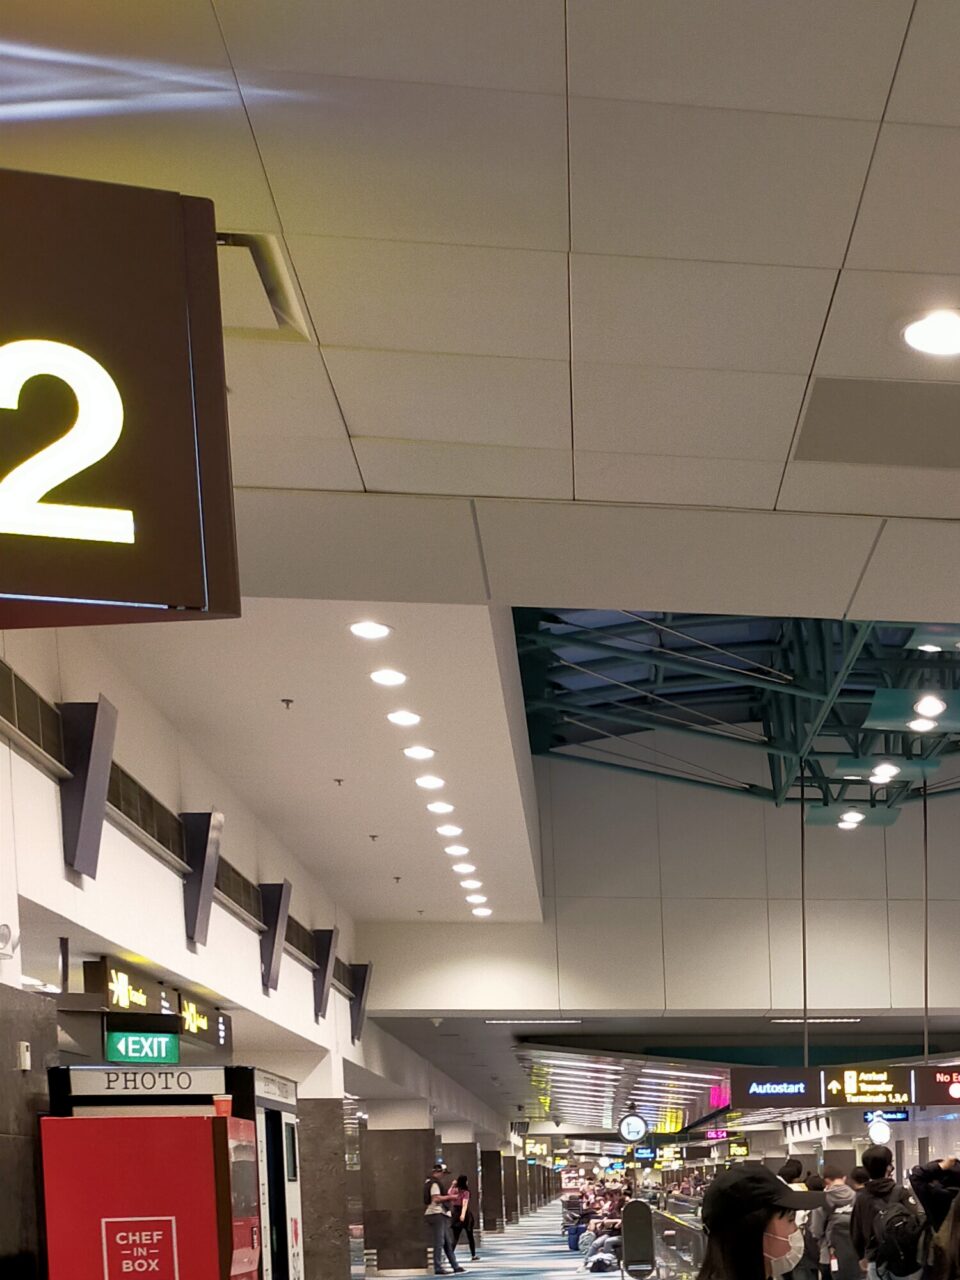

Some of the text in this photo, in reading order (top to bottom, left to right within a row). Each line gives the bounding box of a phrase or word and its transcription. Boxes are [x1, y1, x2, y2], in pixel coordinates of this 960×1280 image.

[0, 339, 135, 544] 2
[128, 1037, 169, 1057] EXIT
[104, 1071, 192, 1090] PHOTO
[936, 1073, 950, 1082] No
[749, 1082, 805, 1094] Autostart
[115, 1231, 163, 1245] CHEF
[133, 1247, 147, 1256] IN
[122, 1259, 160, 1272] BOX
